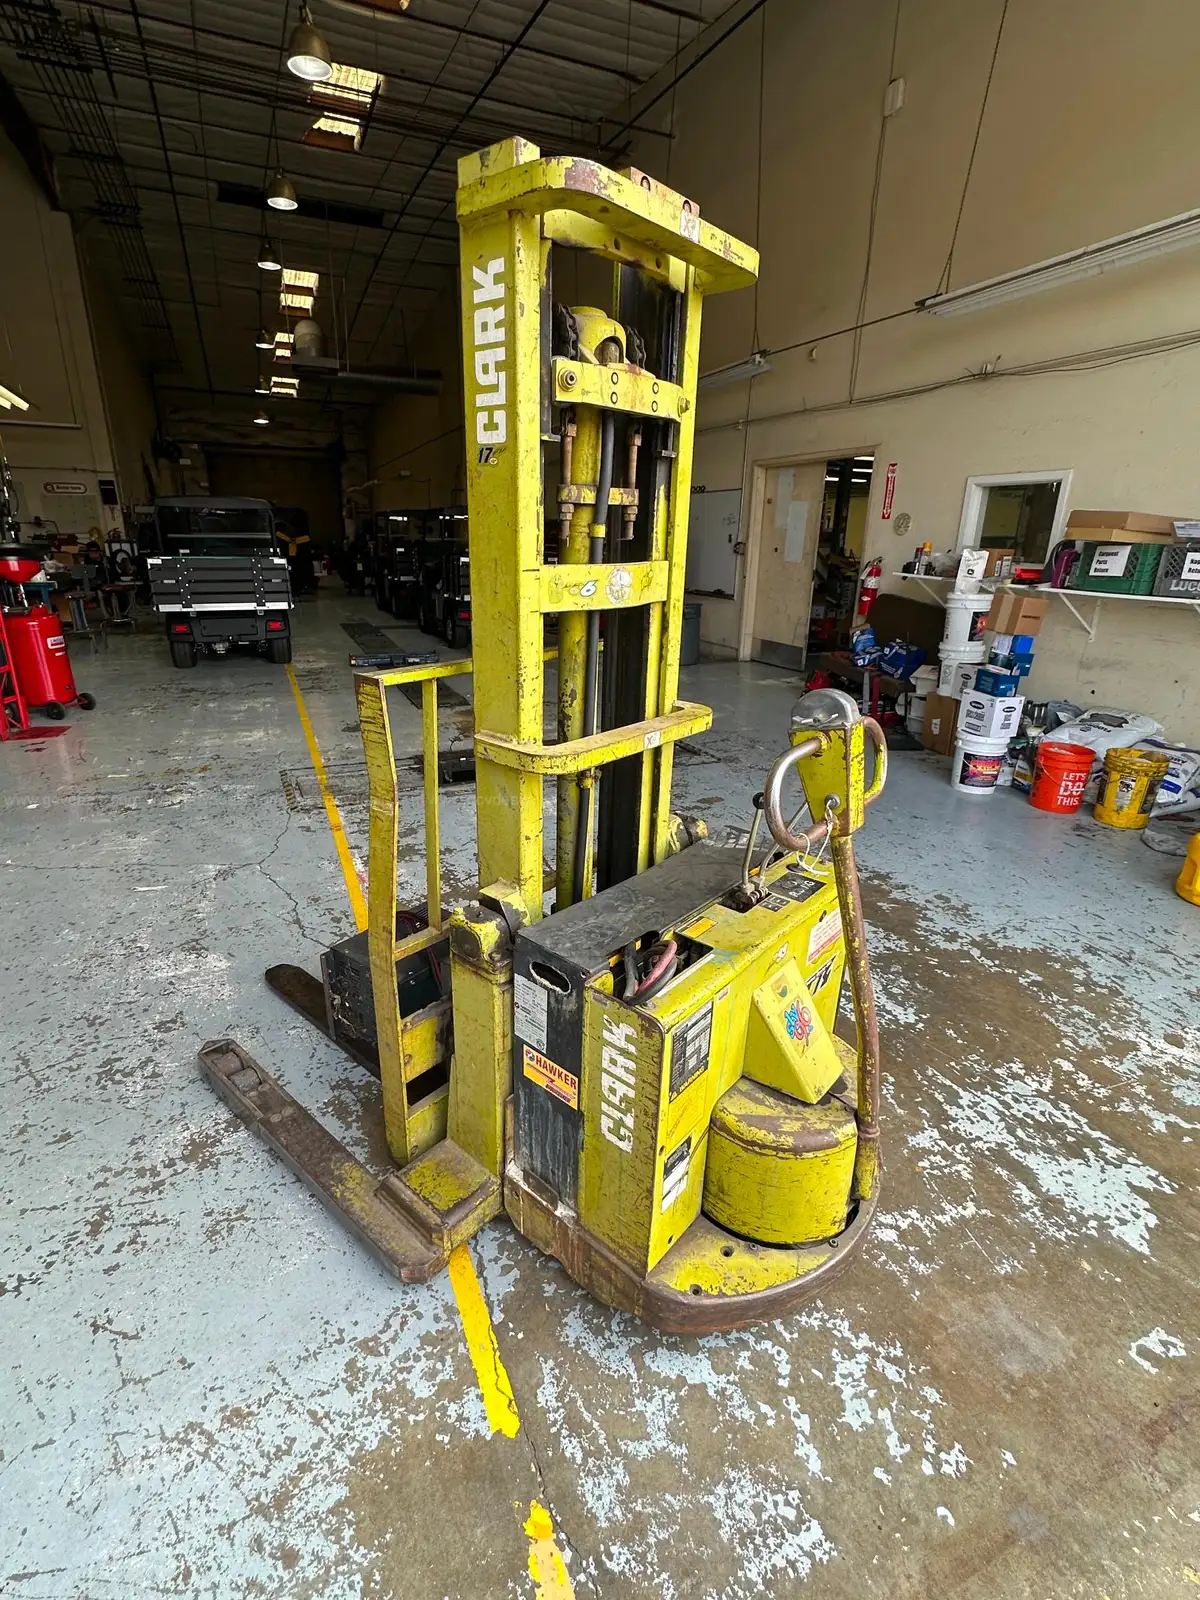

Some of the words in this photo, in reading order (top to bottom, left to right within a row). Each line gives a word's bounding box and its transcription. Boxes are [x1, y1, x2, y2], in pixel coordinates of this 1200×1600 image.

[472, 257, 507, 444] CLARK
[580, 580, 598, 597] 6
[1059, 781, 1085, 796] DO
[535, 1055, 577, 1090] HAWKER
[600, 1014, 638, 1154] CLARK
